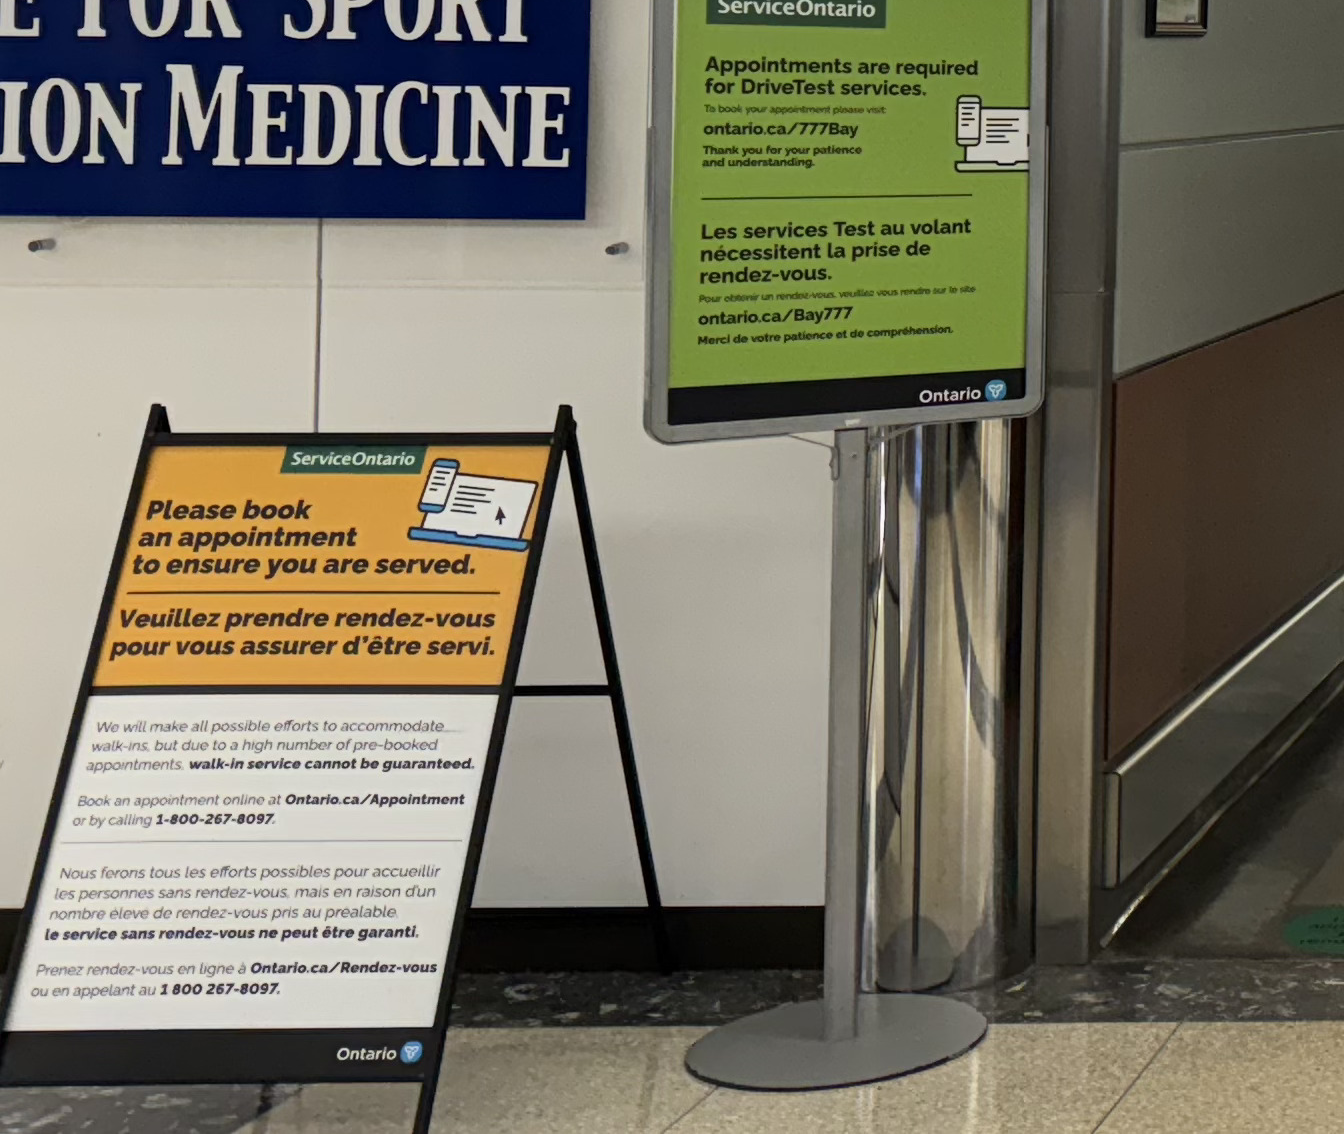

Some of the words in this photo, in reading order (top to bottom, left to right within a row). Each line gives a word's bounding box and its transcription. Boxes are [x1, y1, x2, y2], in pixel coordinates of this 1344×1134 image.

[705, 56, 852, 77] Appointments
[858, 61, 890, 75] are
[896, 60, 978, 79] required
[705, 79, 734, 94] for
[741, 79, 835, 95] DriveTest
[841, 81, 926, 96] services.
[704, 122, 858, 139] ontario.ca/777Bay
[703, 145, 738, 155] Thank
[742, 147, 763, 157] you
[766, 145, 782, 155] for
[785, 147, 810, 157] your
[813, 145, 862, 157] patience
[702, 158, 725, 167] and
[728, 158, 815, 169] understanding.
[701, 223, 737, 240] Les
[743, 223, 828, 239] services
[834, 221, 875, 236] Test
[881, 223, 905, 236] au
[910, 219, 971, 235] volant
[700, 242, 821, 262] nécessitent
[828, 242, 845, 258] la
[852, 241, 900, 261] prise
[906, 241, 931, 256] de
[700, 265, 832, 284] rendez-vous.
[698, 307, 853, 326] ontario.ca/Bay777
[919, 387, 981, 403] Ontario
[291, 451, 415, 466] ServiceOntario
[147, 499, 237, 520] Please
[242, 499, 312, 520] book
[138, 530, 171, 547] an
[177, 527, 357, 551] appointment
[132, 556, 160, 574] to
[166, 557, 261, 574] ensure
[265, 558, 317, 579] you
[323, 557, 369, 574] are
[375, 554, 476, 574] served.
[120, 608, 219, 627] Veuillez
[225, 609, 329, 632] prendre
[335, 608, 495, 628] rendez-vous
[109, 640, 170, 661] pour
[177, 640, 234, 655] vous
[240, 640, 338, 655] assurer
[426, 637, 495, 655] servi.
[189, 758, 244, 770] walk-in
[247, 758, 300, 770] service
[304, 759, 356, 770] cannot
[359, 758, 379, 770] be
[382, 758, 475, 772] guaranteed.
[77, 794, 110, 807] Book
[114, 797, 130, 806] an
[134, 794, 219, 809] appointment
[222, 794, 265, 806] online
[269, 795, 281, 806] at
[285, 792, 464, 807] Ontario.ca/Appointment
[45, 927, 59, 940] le
[62, 927, 117, 940] service
[120, 929, 155, 940] sans
[159, 926, 255, 940] rendez-vous
[259, 929, 277, 939] ne
[280, 927, 318, 942] peut
[322, 925, 355, 939] être
[358, 925, 420, 941] garanti.
[337, 1046, 396, 1062] Ontario
